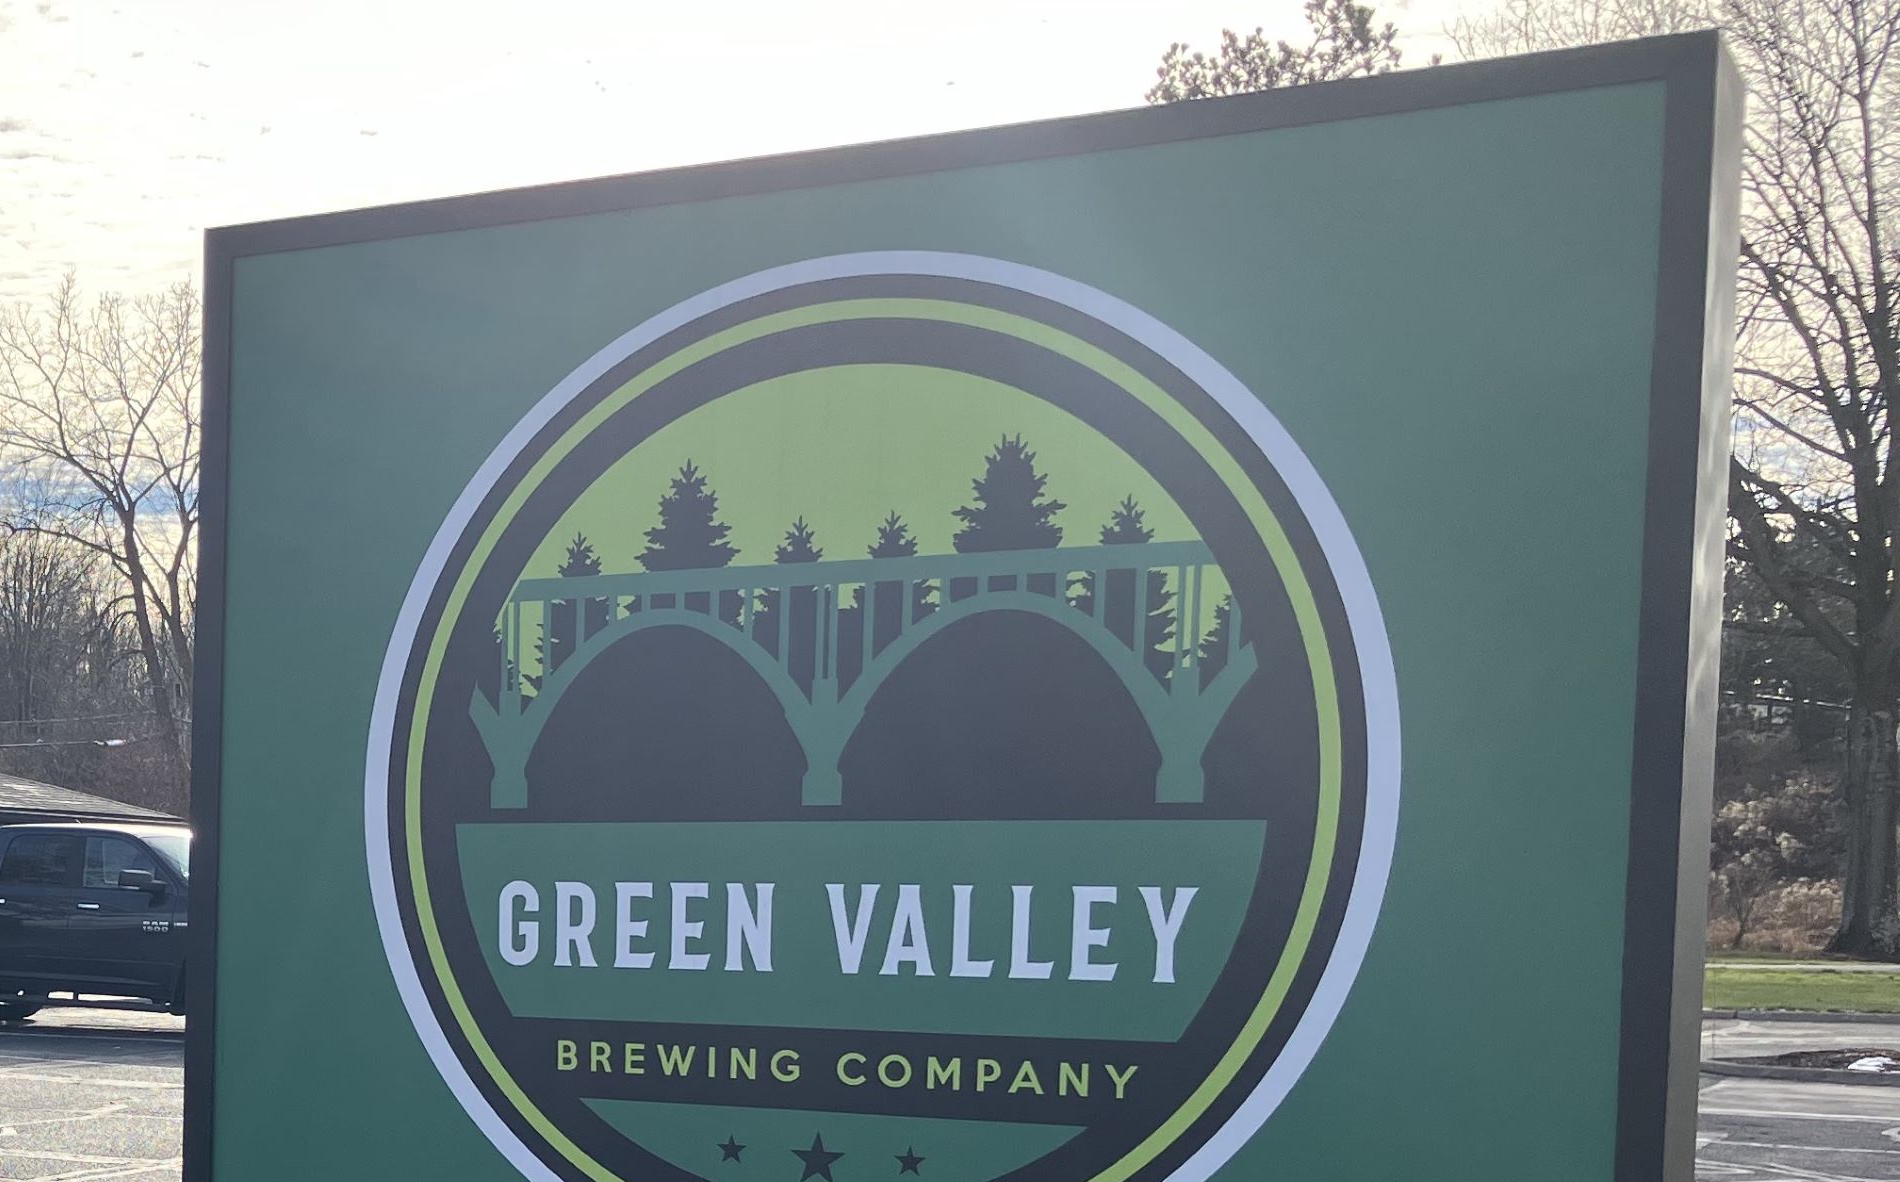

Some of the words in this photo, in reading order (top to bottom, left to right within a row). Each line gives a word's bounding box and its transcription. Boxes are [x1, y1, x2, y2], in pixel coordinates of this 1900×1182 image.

[498, 879, 775, 973] GREEN
[825, 882, 1199, 983] VALLEY
[557, 1039, 801, 1083] BREWING
[837, 1052, 1138, 1100] COMPANY
